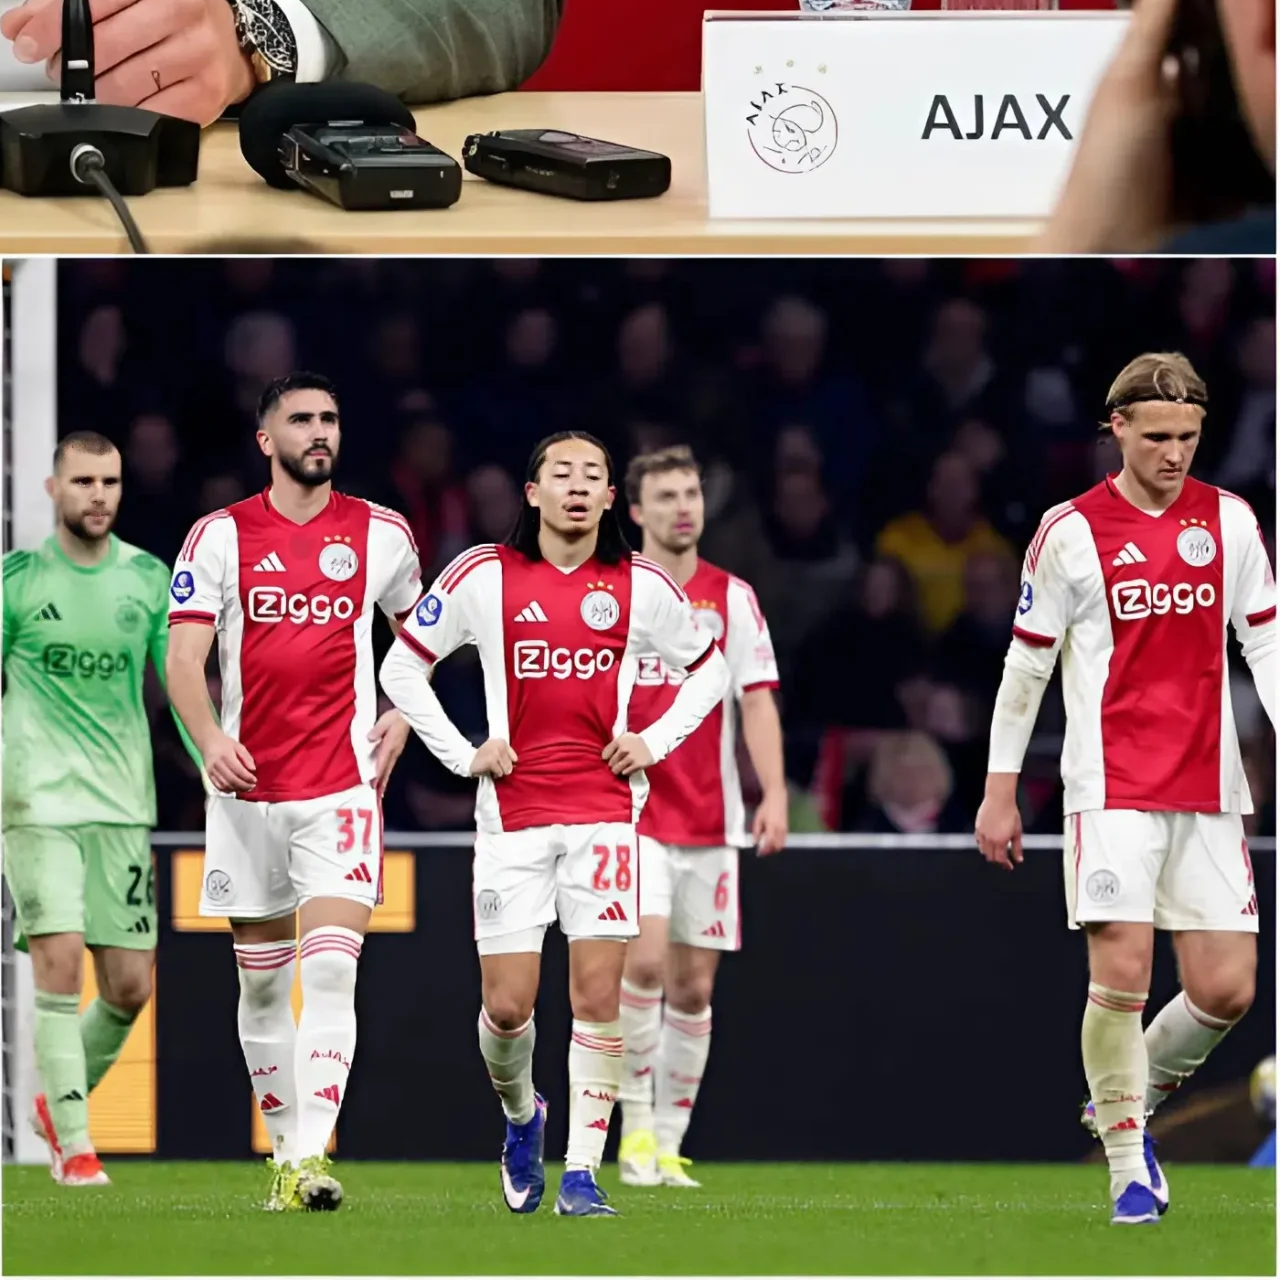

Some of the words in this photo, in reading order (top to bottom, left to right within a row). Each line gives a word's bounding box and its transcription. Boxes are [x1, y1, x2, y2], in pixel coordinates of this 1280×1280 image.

[920, 93, 1074, 141] AJAX
[249, 586, 354, 623] Ziggo
[1112, 578, 1216, 621] Ziggo
[43, 643, 128, 680] Ziggo
[514, 640, 615, 679] Ziggo
[337, 809, 372, 854] 37
[592, 845, 631, 891] 28
[715, 872, 729, 911] 6
